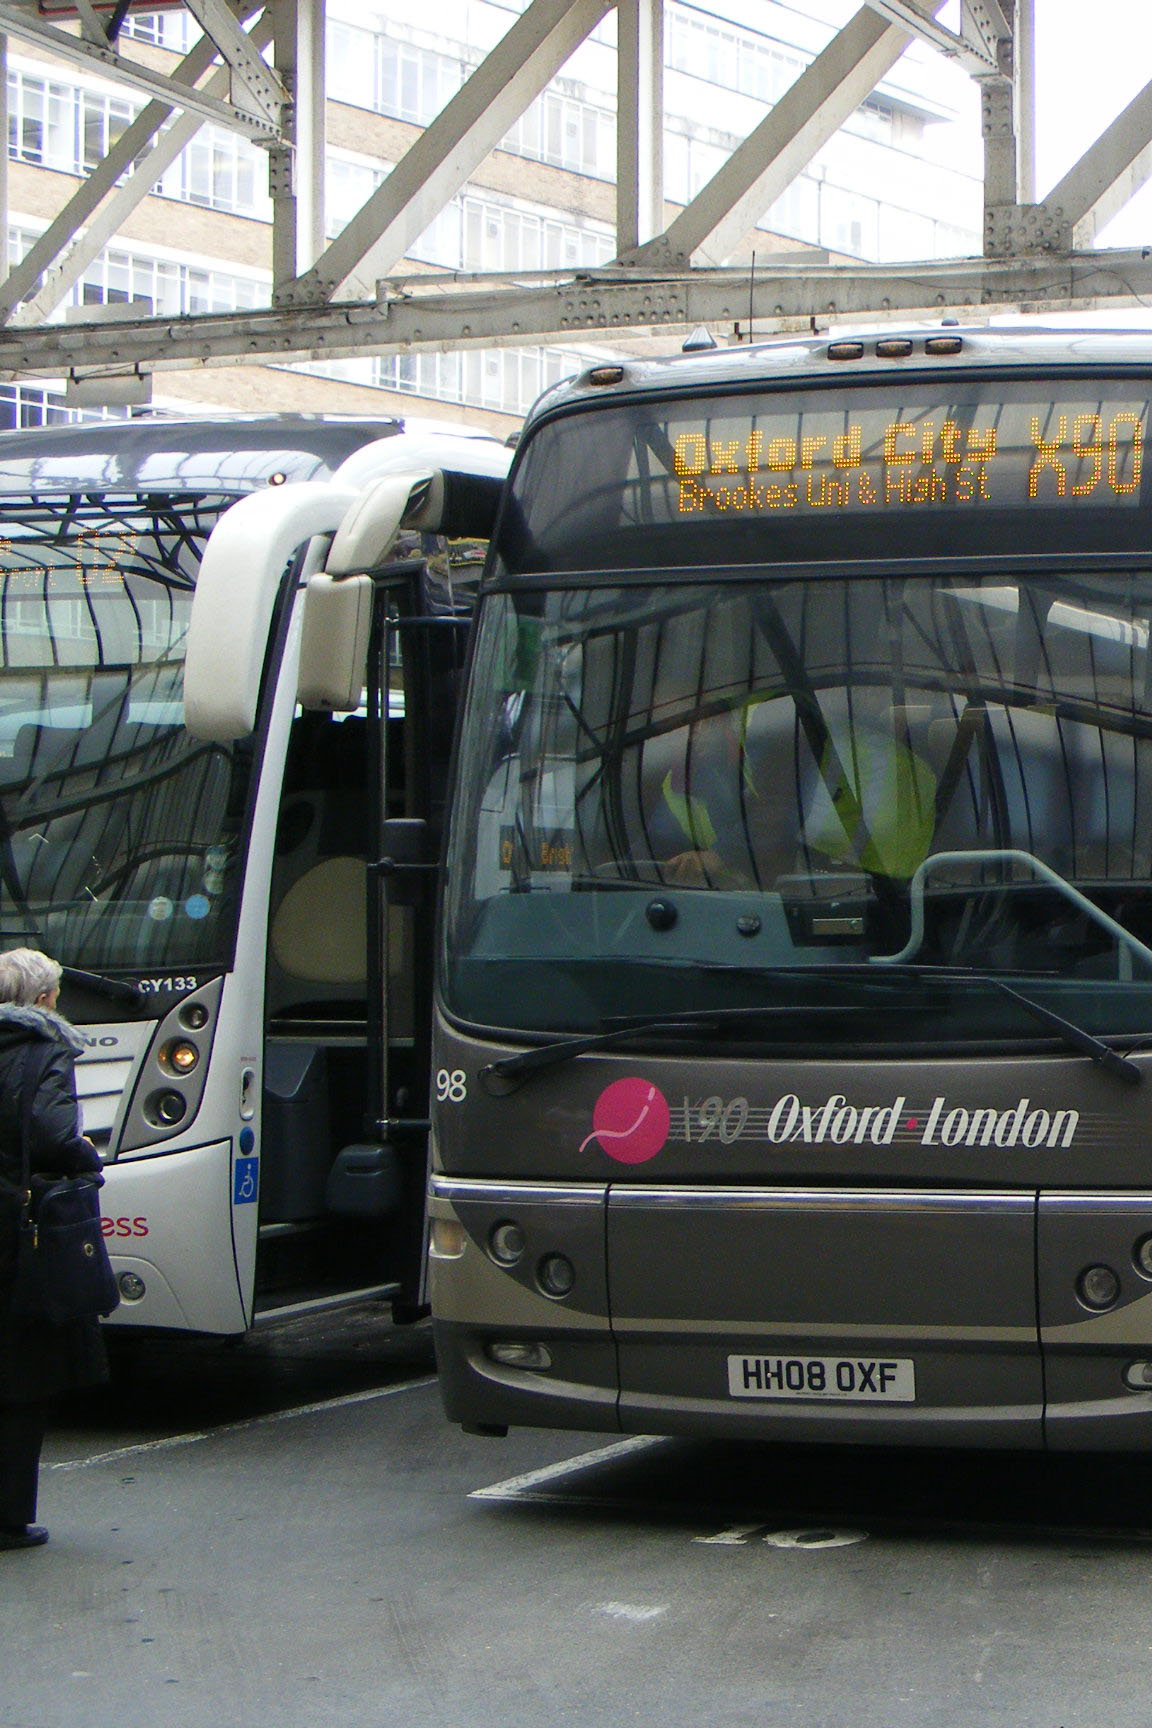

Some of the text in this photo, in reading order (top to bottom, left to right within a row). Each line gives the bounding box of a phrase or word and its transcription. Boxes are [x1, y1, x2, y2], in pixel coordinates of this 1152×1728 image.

[674, 419, 997, 476] Oxford City
[1028, 412, 1143, 498] X90
[678, 465, 991, 512] Brookes Uni & High St
[138, 976, 198, 994] CY133
[436, 1068, 467, 1103] 98
[766, 1093, 907, 1145] Oxford
[920, 1097, 1080, 1148] London
[742, 1359, 898, 1393] HH08 OXF
